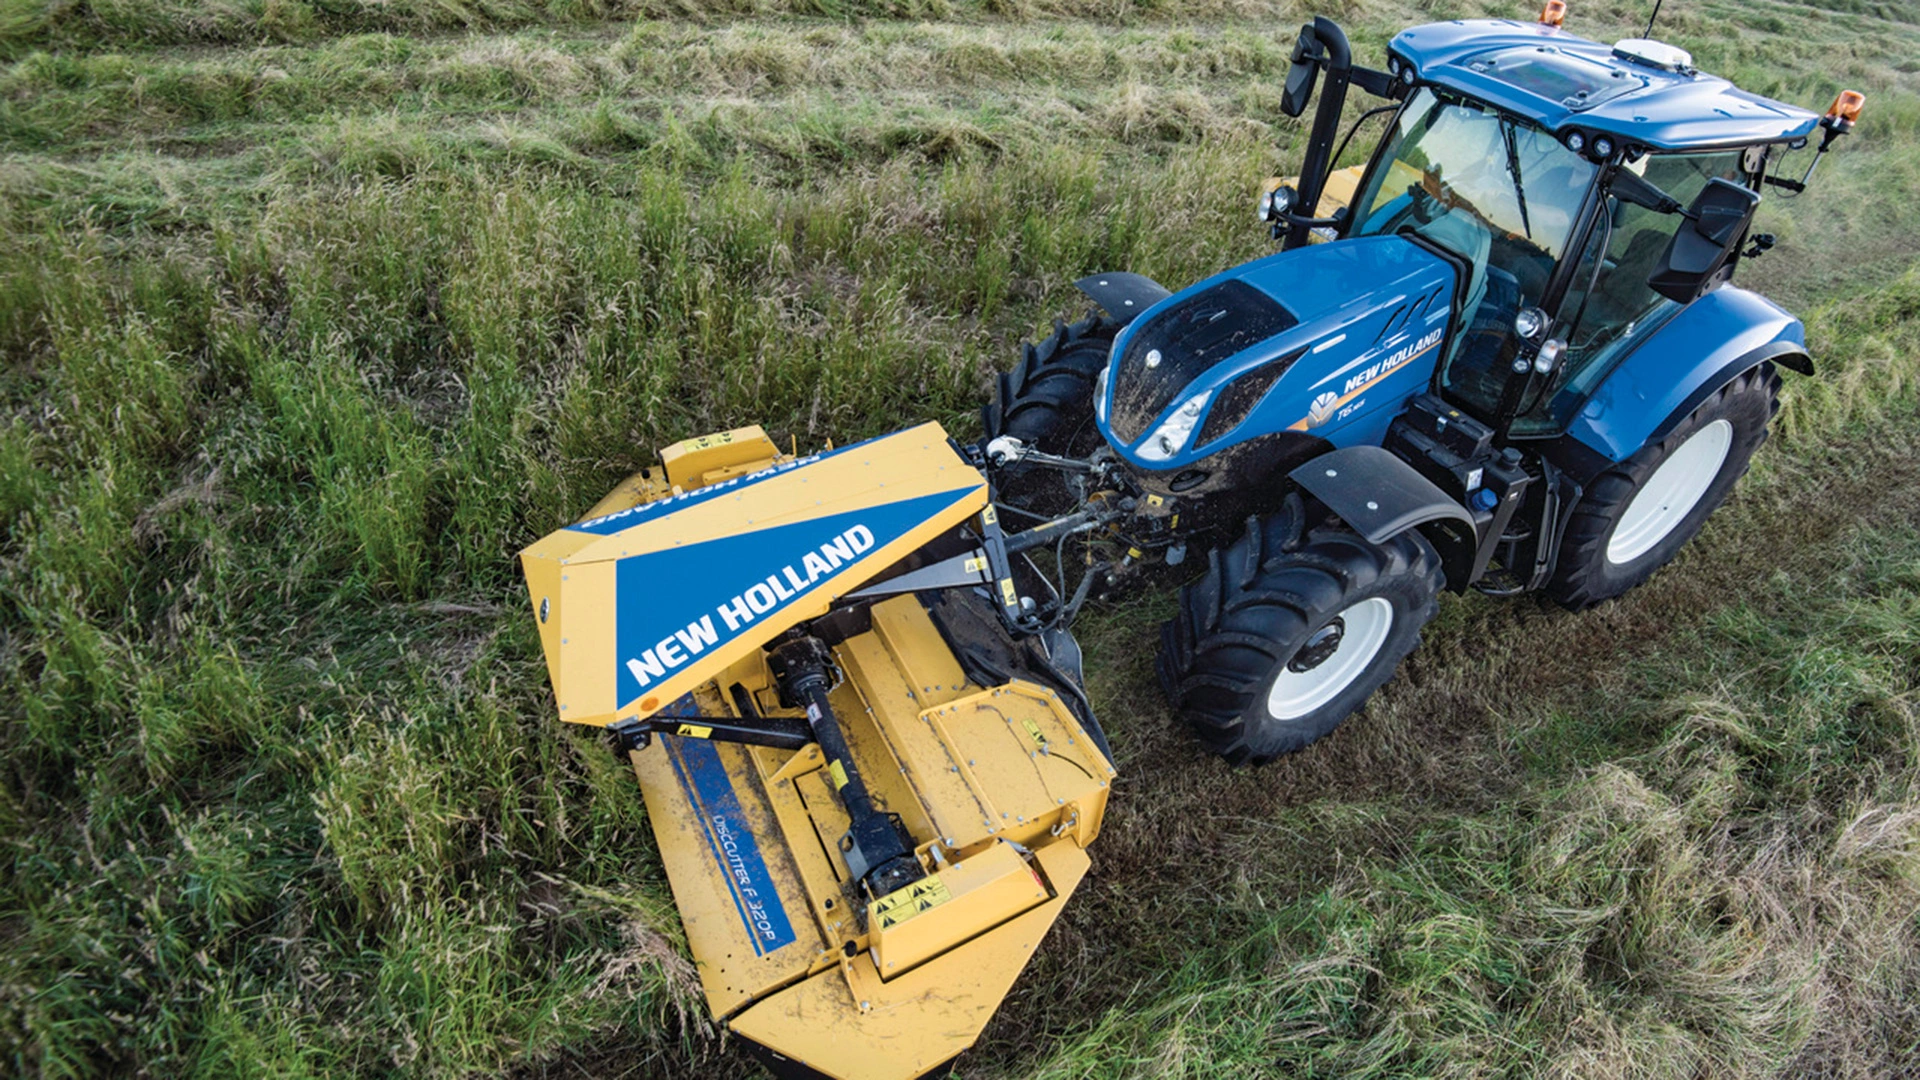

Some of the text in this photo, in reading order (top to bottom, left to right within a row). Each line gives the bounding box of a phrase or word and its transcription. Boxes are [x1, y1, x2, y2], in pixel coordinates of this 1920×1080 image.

[1344, 328, 1442, 394] NEW HOLLAND
[626, 524, 875, 687] NEW HOLLAND
[712, 815, 776, 941] DISCCUTTER F 320P
